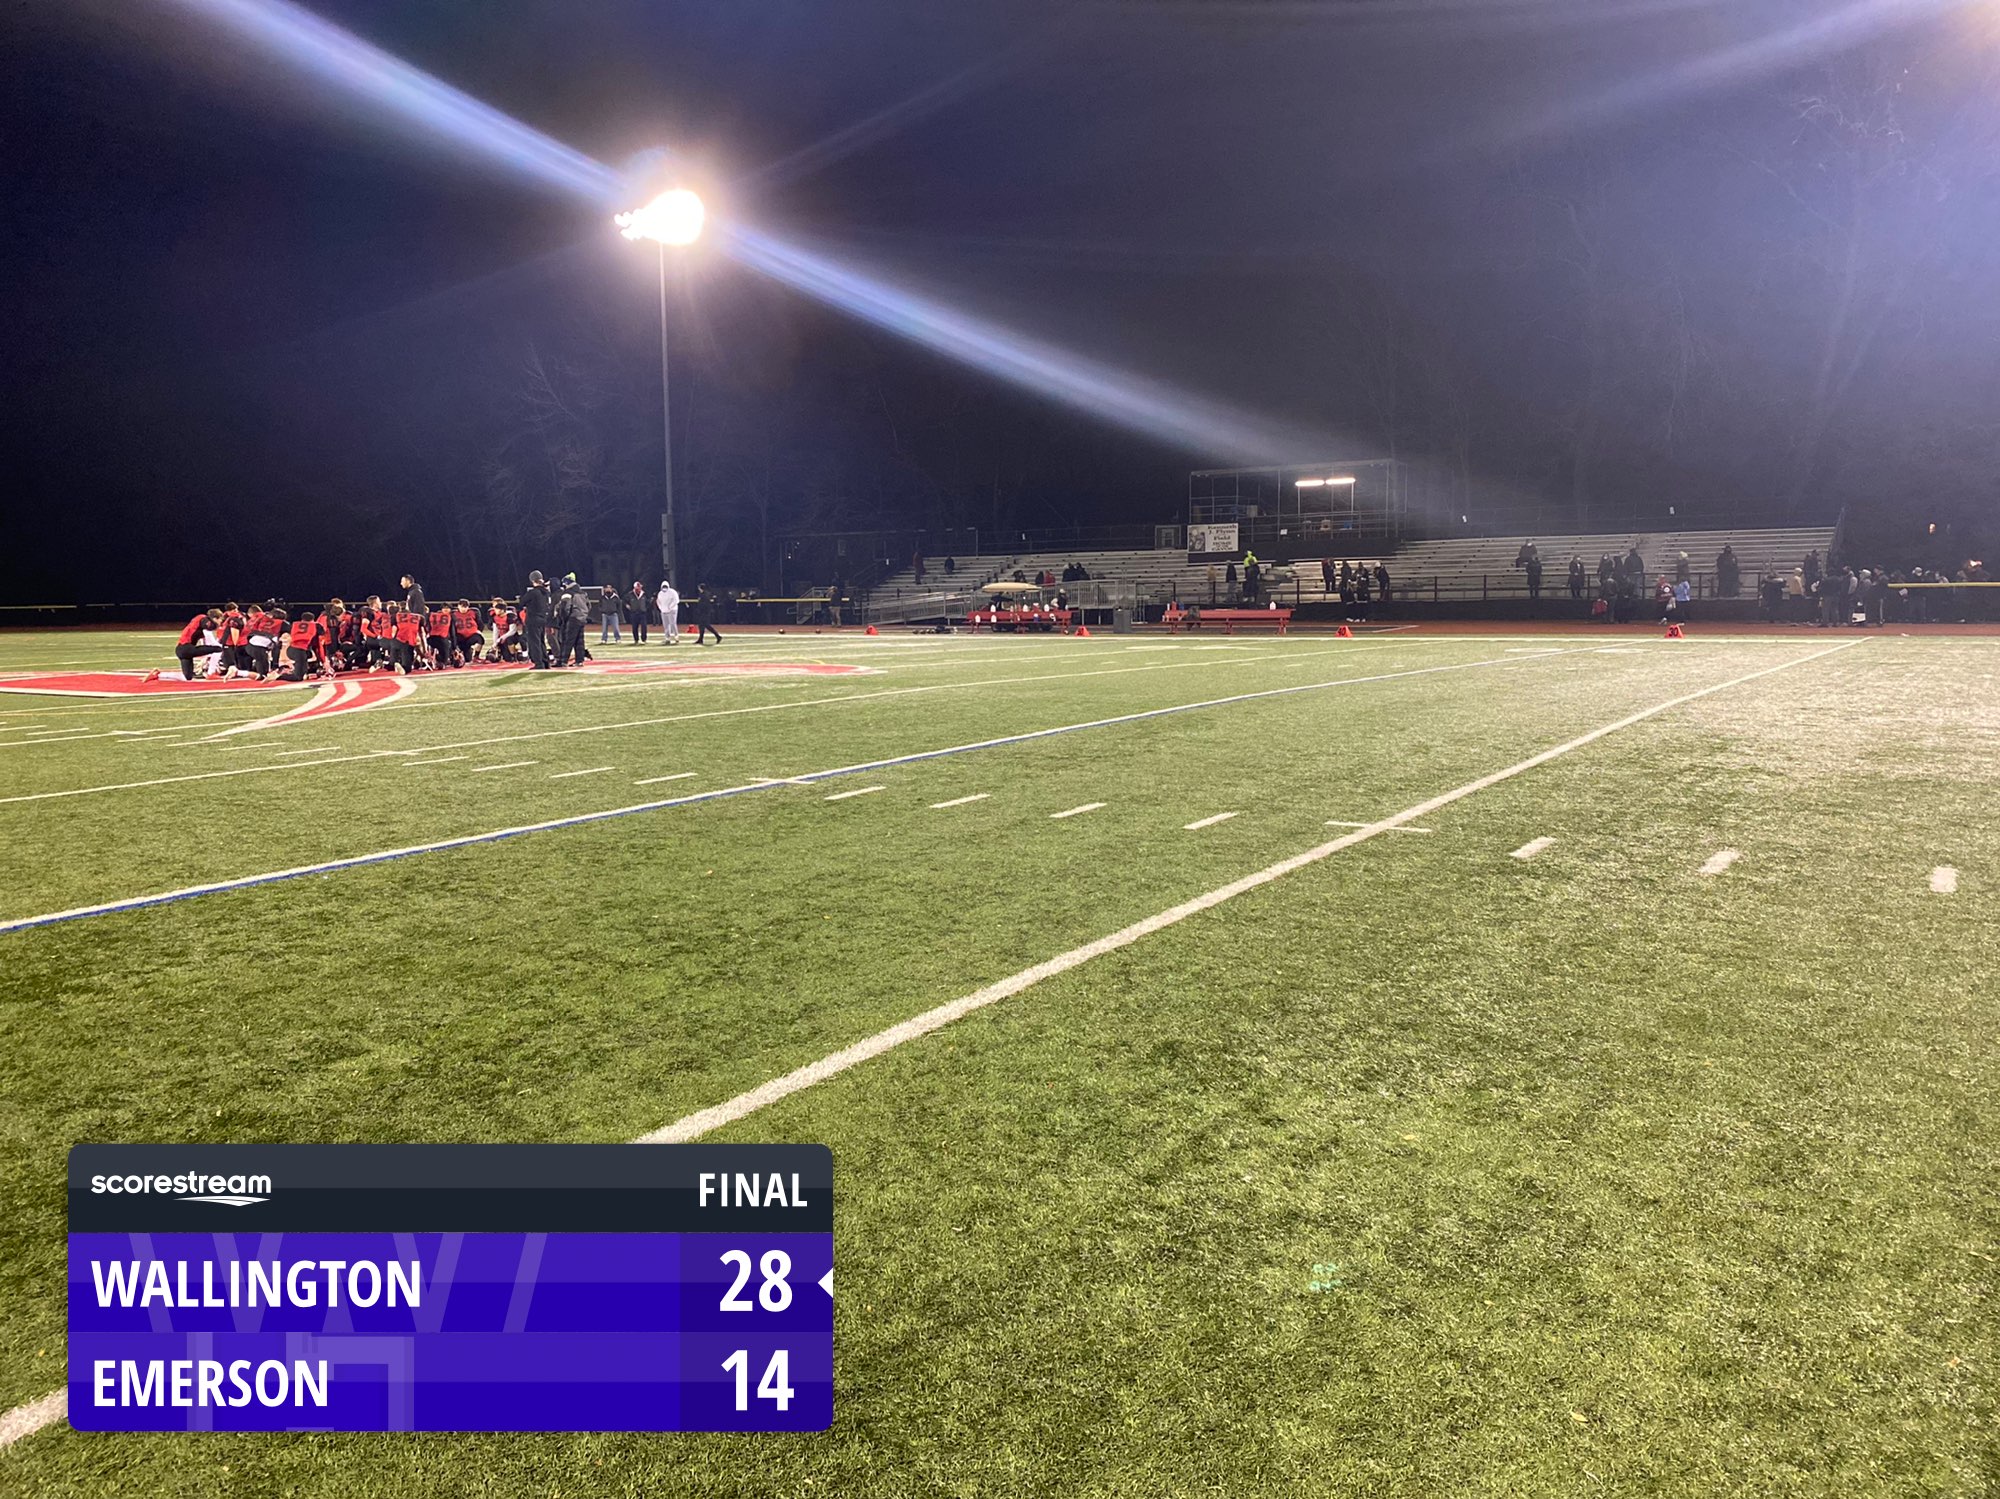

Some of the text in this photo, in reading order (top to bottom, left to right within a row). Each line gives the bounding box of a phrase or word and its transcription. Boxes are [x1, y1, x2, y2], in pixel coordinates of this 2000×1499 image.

[399, 613, 419, 624] 22
[299, 622, 309, 633] 9
[1669, 627, 1678, 637] 30
